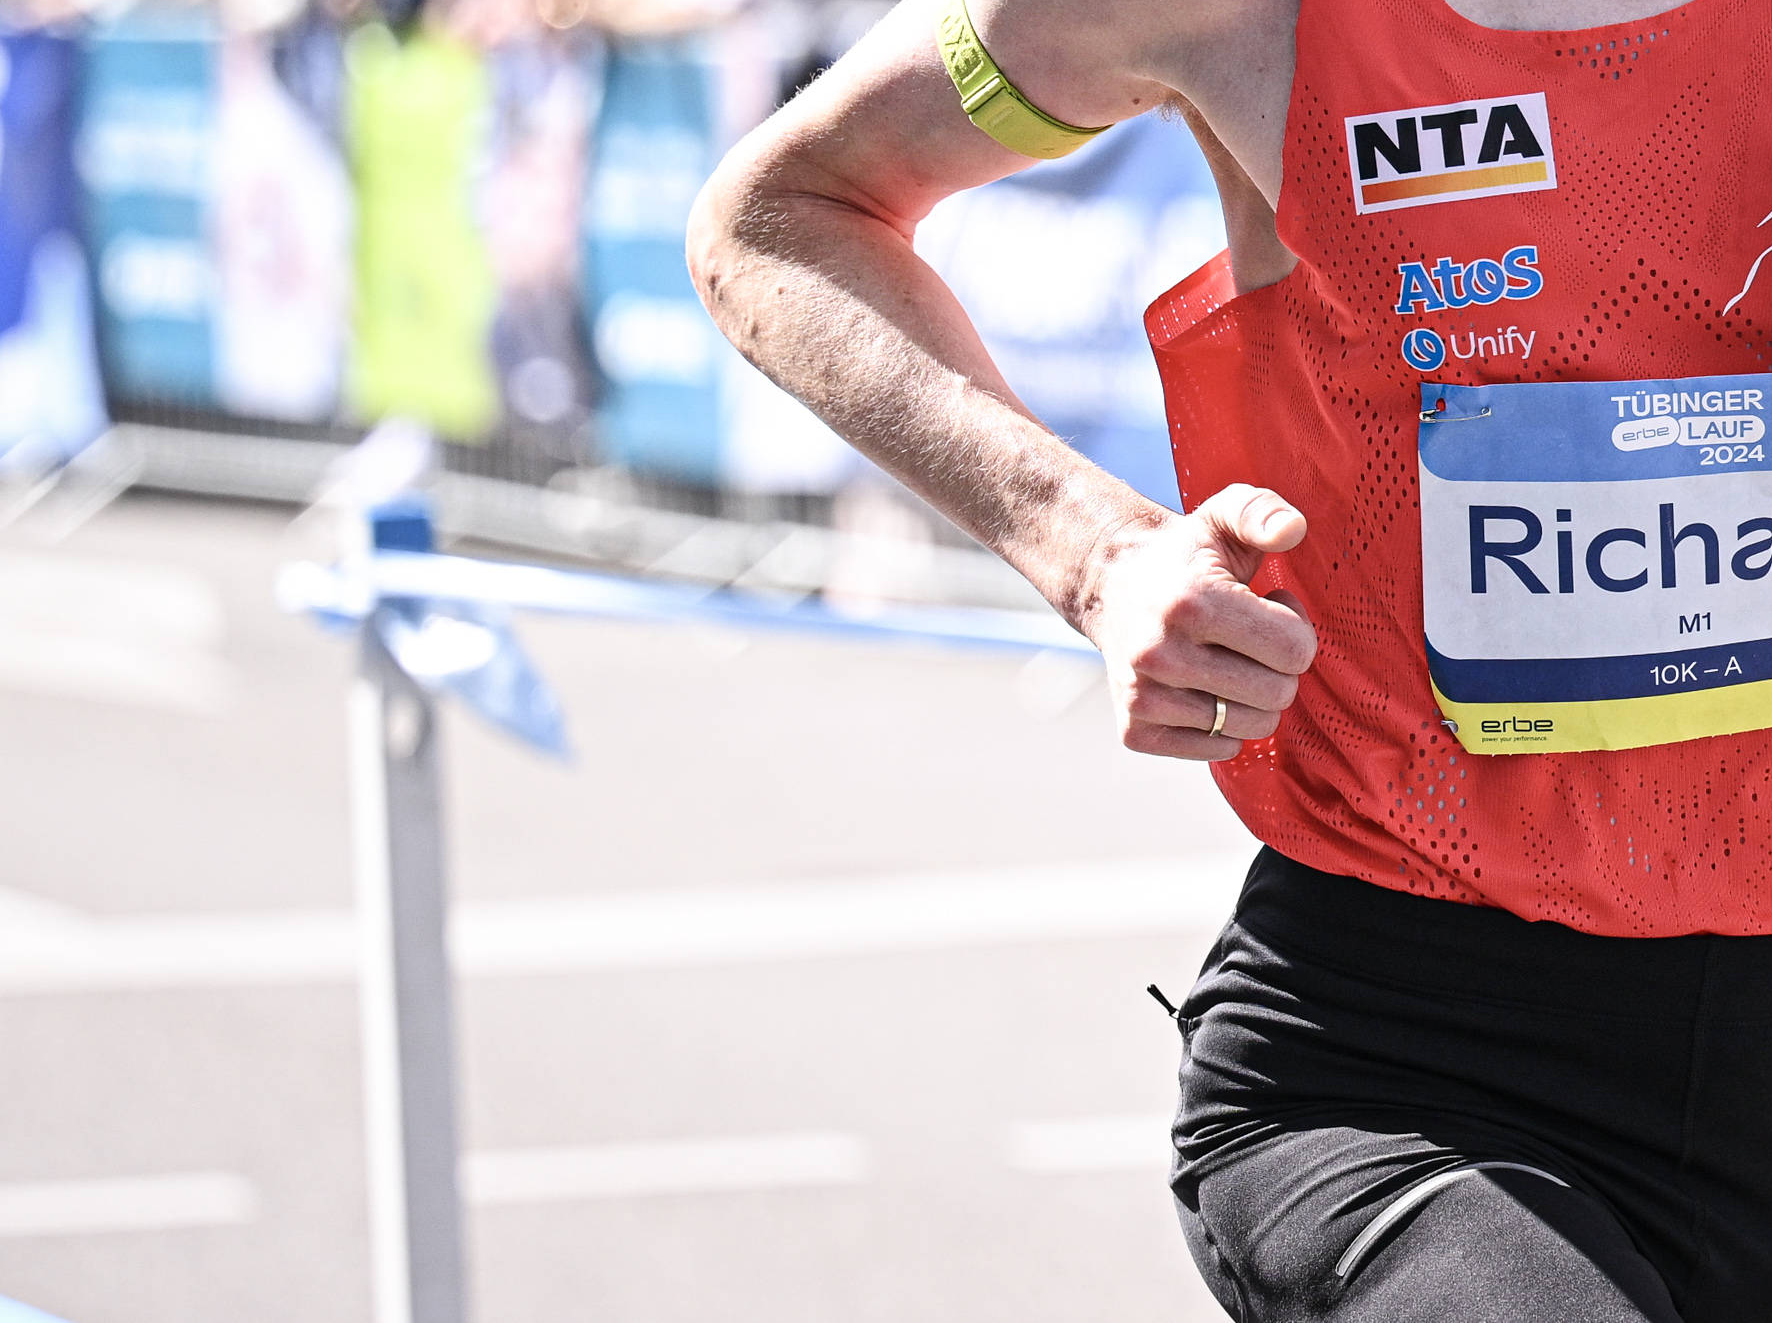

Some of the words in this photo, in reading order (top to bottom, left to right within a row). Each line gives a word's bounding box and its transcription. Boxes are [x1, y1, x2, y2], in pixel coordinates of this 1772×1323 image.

[1353, 103, 1545, 181] NTA
[1450, 325, 1537, 360] Unify
[1610, 388, 1765, 418] TÜBINGER
[1622, 425, 1671, 442] erbe
[1687, 420, 1754, 440] LAUF
[1699, 444, 1766, 466] 2024
[1679, 612, 1711, 634] M1
[1649, 661, 1698, 686] 10K
[1723, 655, 1743, 677] A
[1481, 716, 1554, 733] erbe
